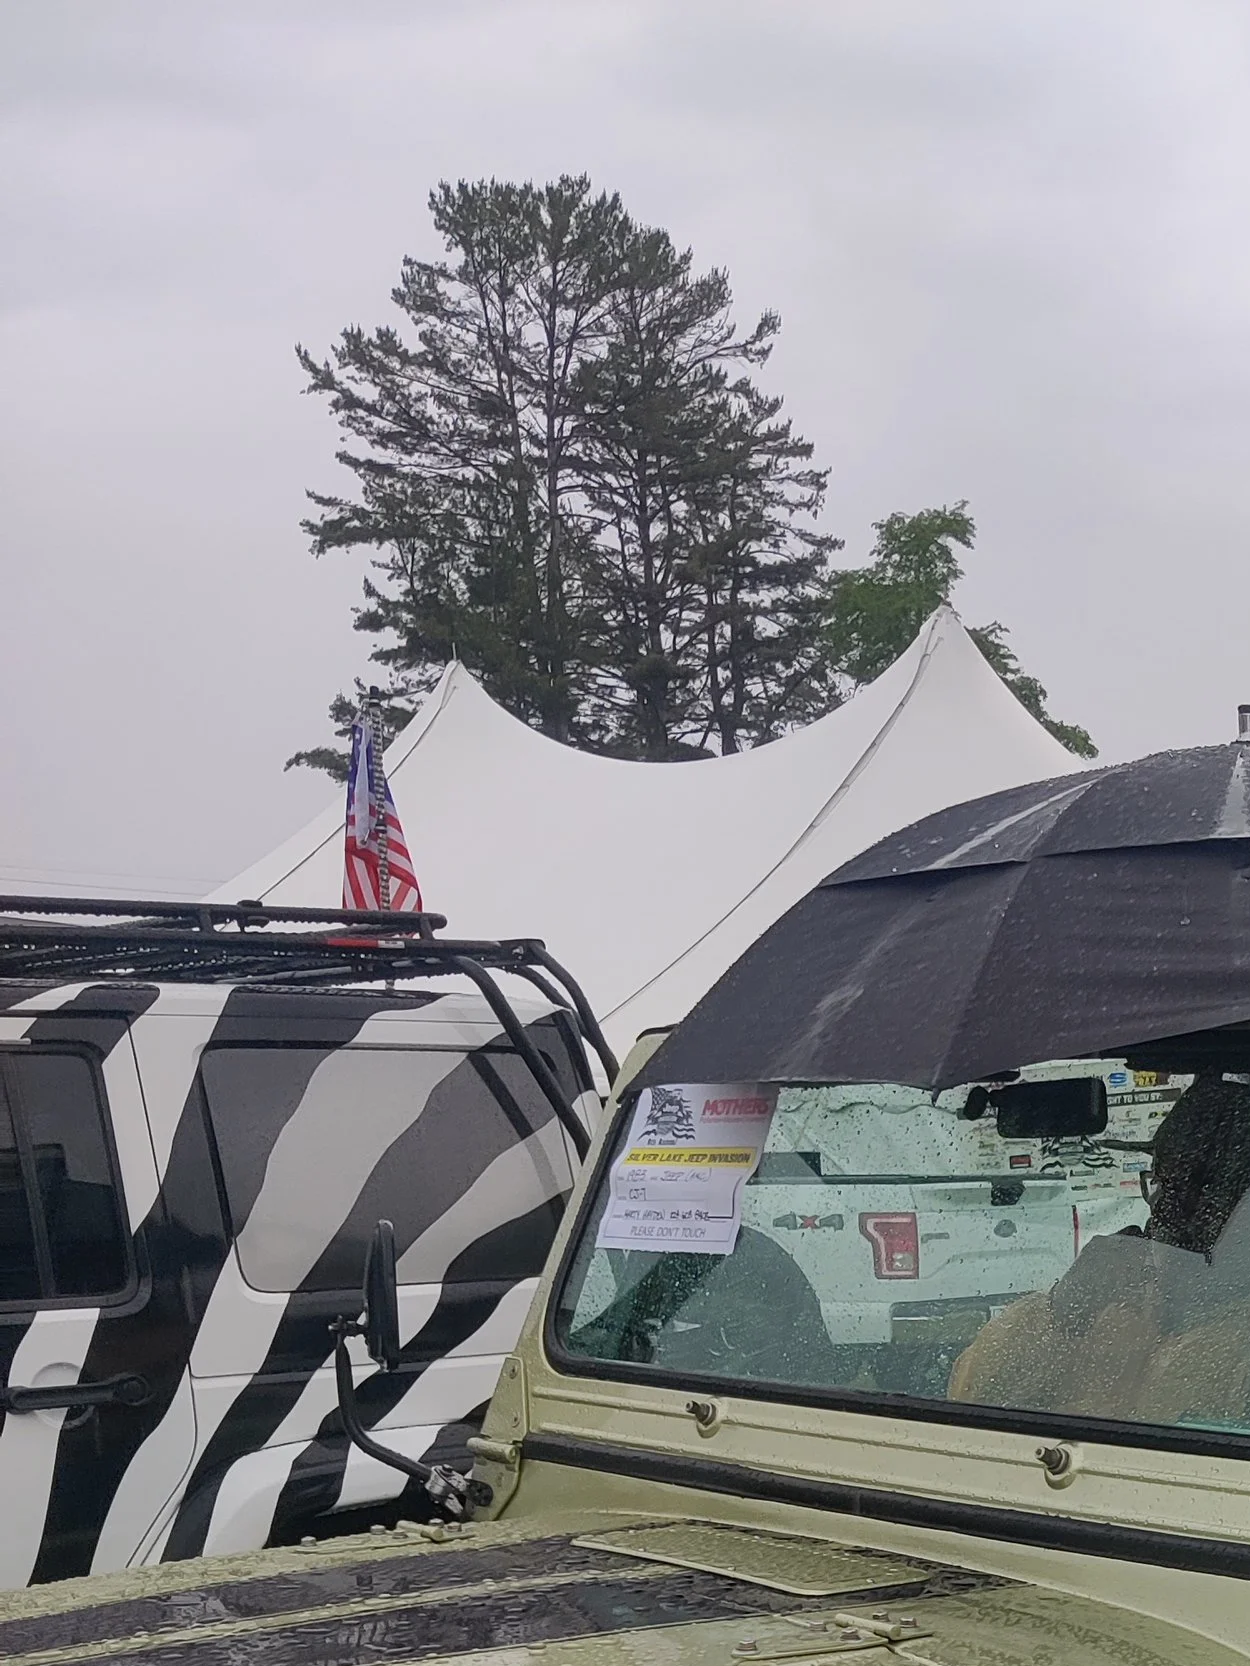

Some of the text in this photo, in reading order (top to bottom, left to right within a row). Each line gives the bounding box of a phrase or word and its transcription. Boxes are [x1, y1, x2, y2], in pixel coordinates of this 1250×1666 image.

[627, 1153, 751, 1164] SILVER LAKE JEEP INVASION
[630, 1226, 656, 1237] PLEASE
[681, 1227, 707, 1239] TOUCH
